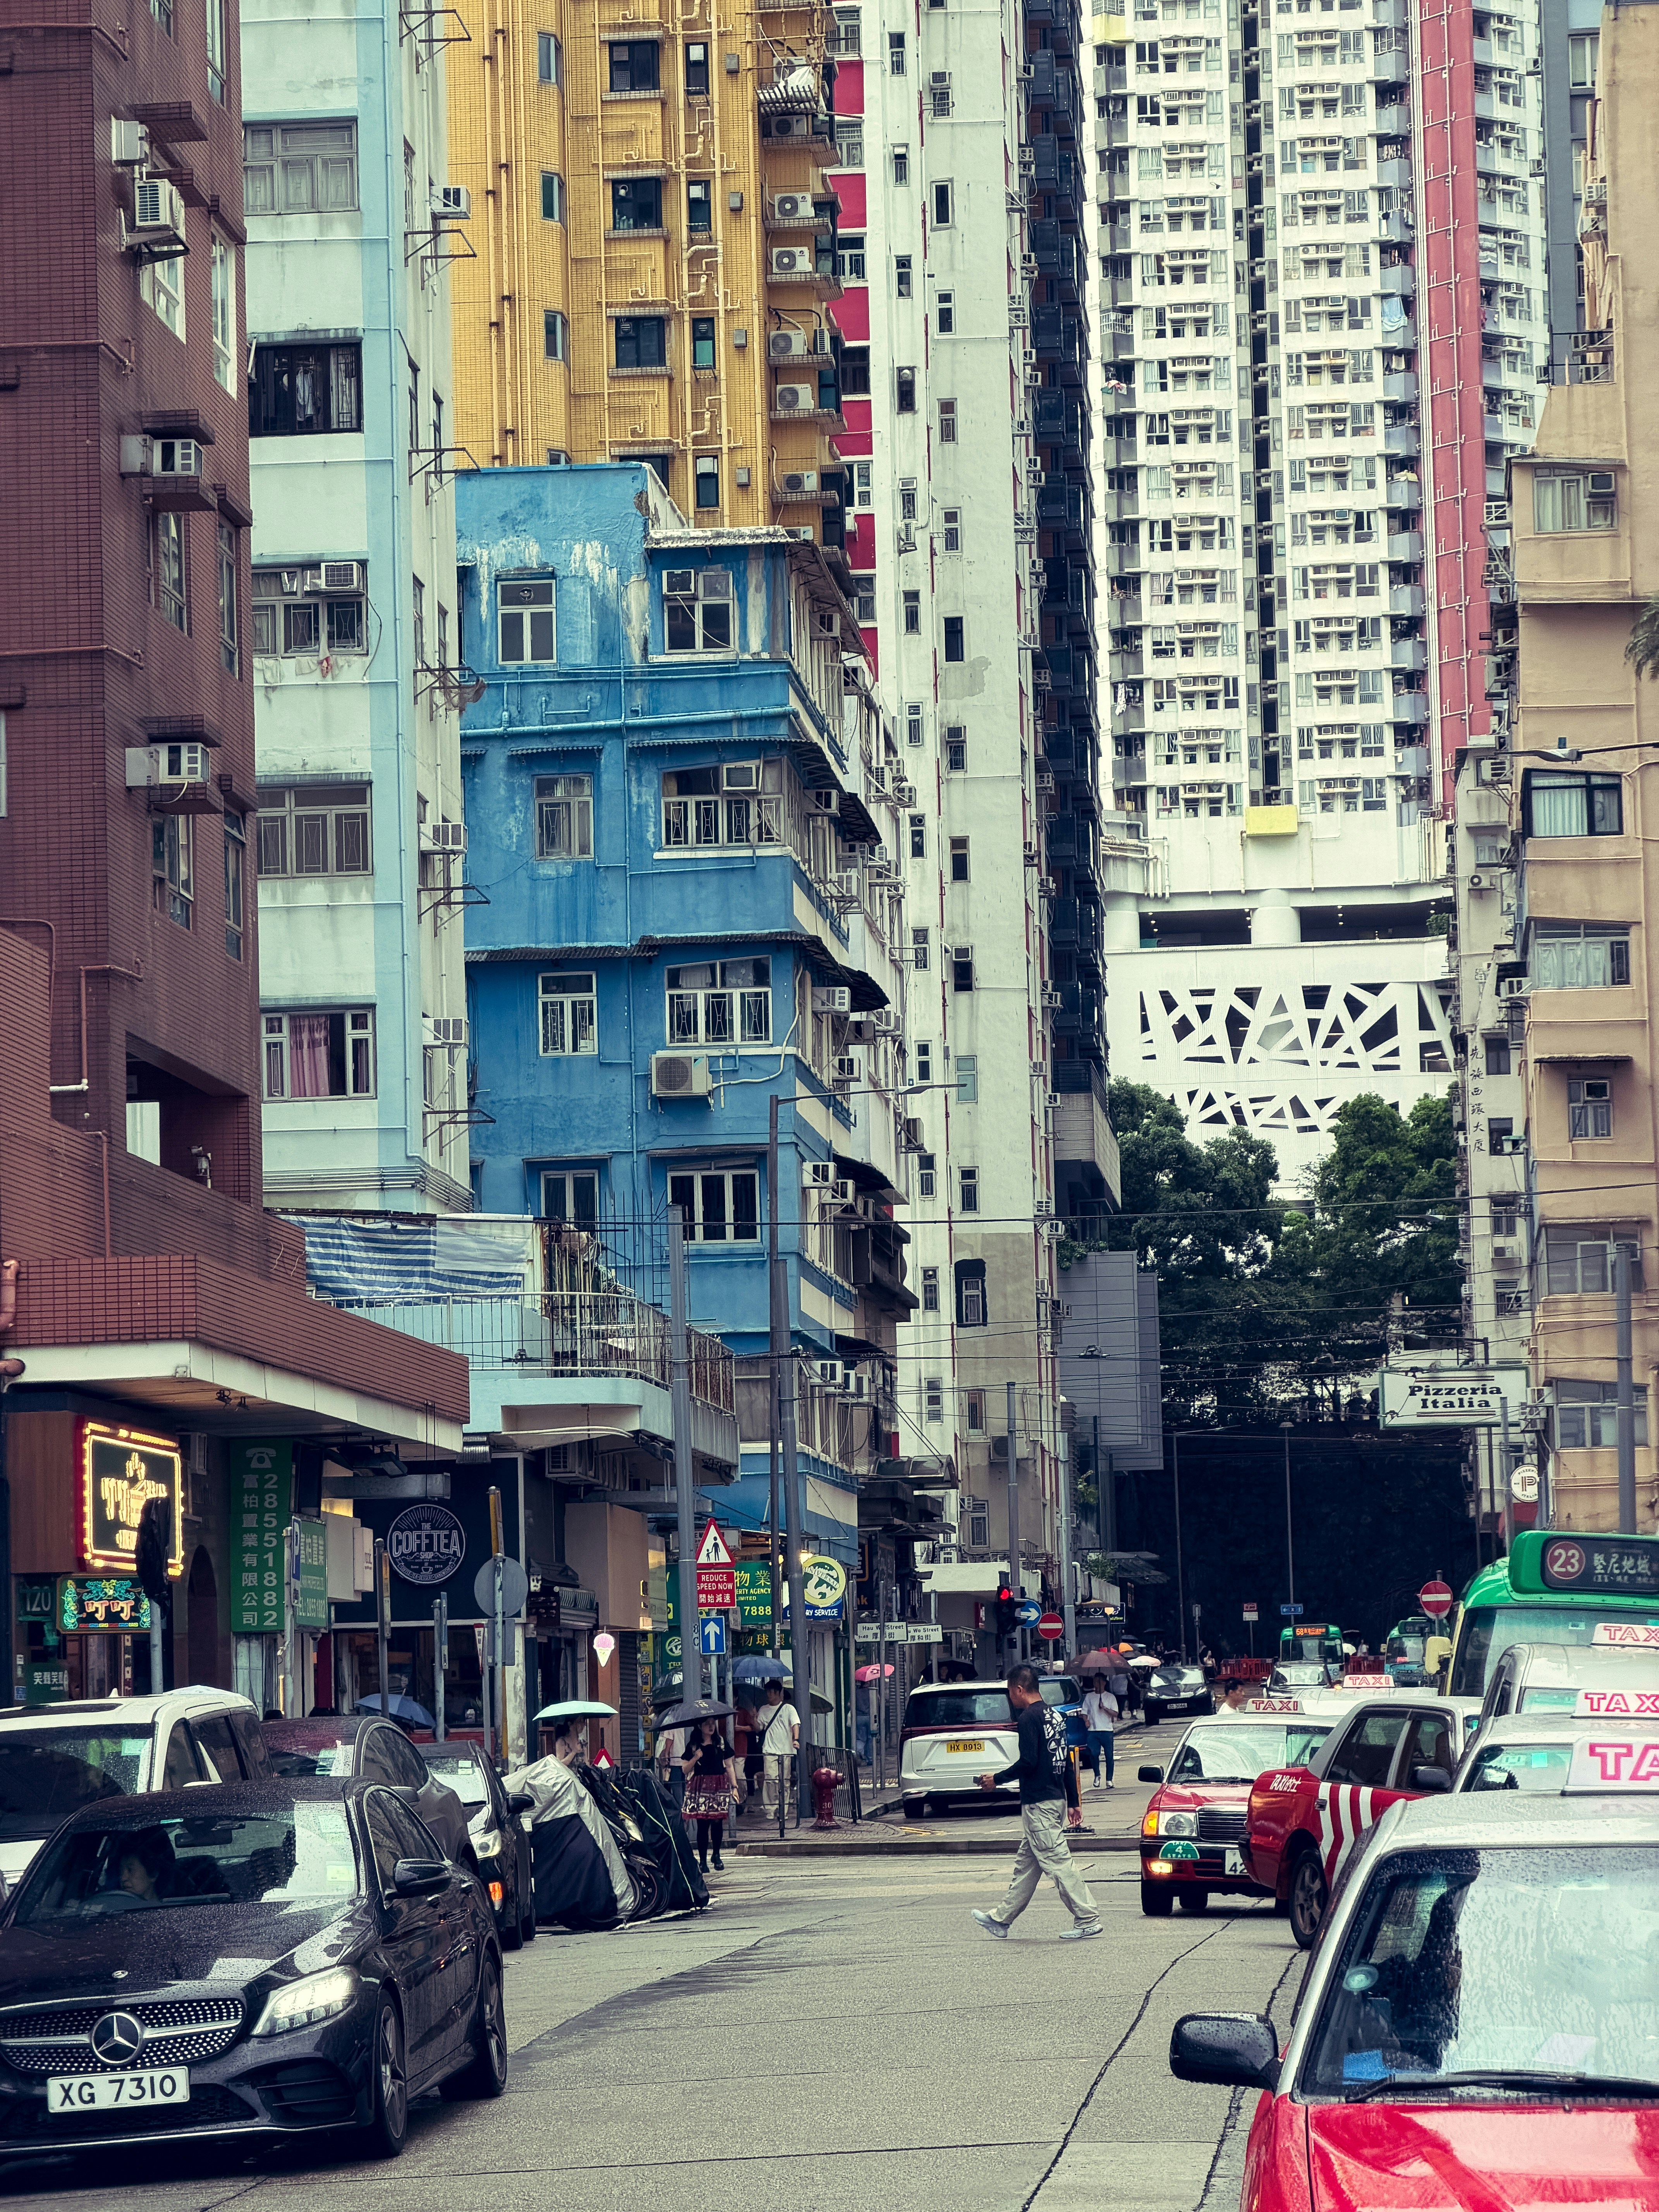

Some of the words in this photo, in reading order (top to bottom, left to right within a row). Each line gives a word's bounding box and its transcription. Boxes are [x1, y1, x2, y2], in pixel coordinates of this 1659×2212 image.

[1409, 1384, 1502, 1396] Pizzeria
[1421, 1397, 1491, 1409] Italia
[263, 1474, 278, 1626] 28551882
[392, 1530, 461, 1557] COFFTEA
[1553, 1549, 1579, 1572] 23
[804, 1567, 838, 1587] UNIVERSAL
[699, 1593, 731, 1603] 開始減速
[85, 1600, 135, 1620] 叮叮
[744, 1606, 771, 1616] 7888
[1603, 1626, 1659, 1642] TAX
[1349, 1676, 1390, 1685] TAXI
[1252, 1700, 1298, 1711] TAXI
[1584, 1693, 1659, 1713] TAX
[1589, 1743, 1659, 1781] TA
[58, 2082, 96, 2107] XG
[109, 2074, 177, 2103] 7310
